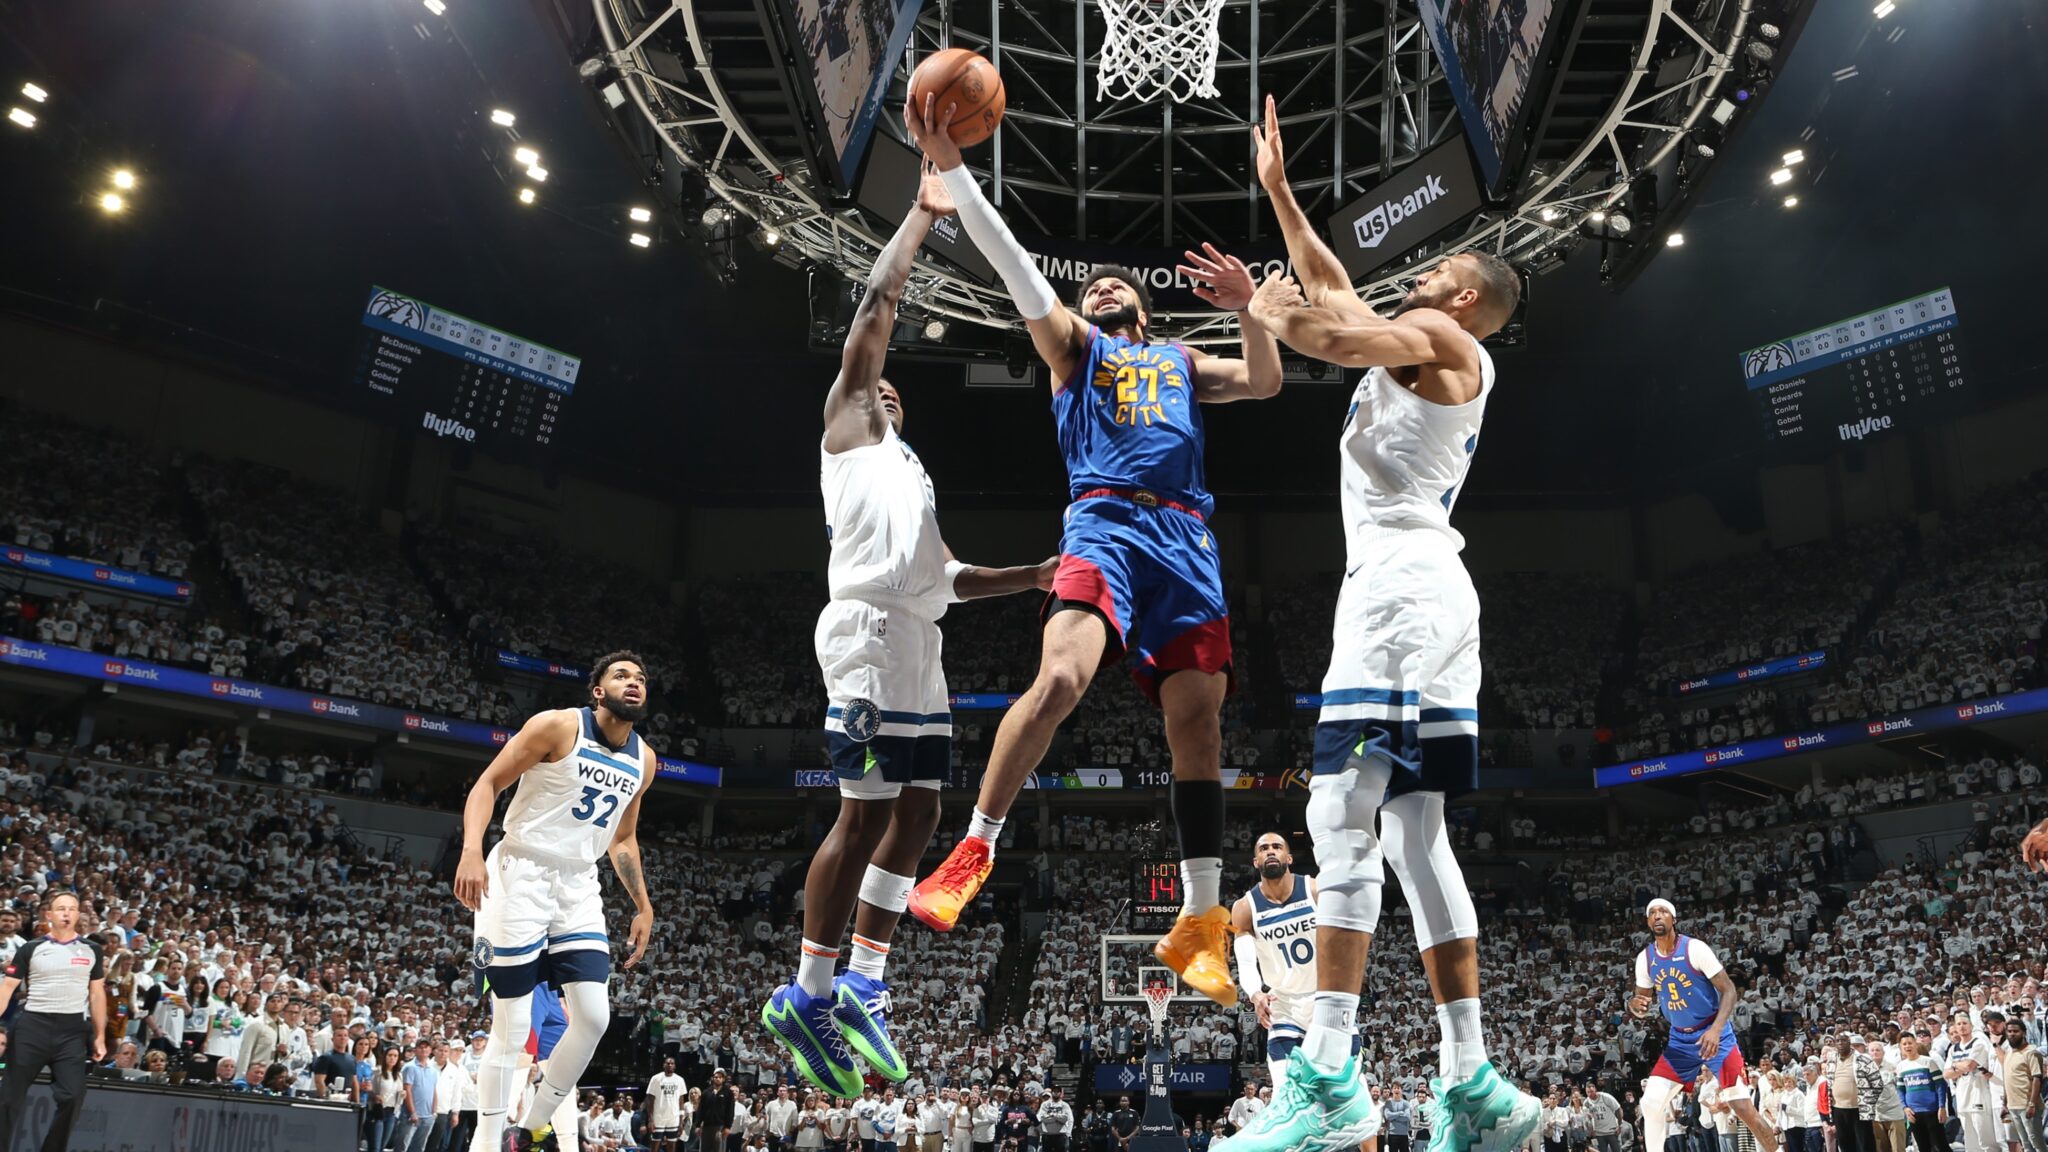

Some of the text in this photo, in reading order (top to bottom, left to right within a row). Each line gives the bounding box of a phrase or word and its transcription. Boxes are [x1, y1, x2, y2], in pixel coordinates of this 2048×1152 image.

[1358, 174, 1446, 242] us bank
[431, 323, 441, 332] 0.0
[450, 330, 460, 338] 0.0
[470, 336, 481, 346] 0.0
[381, 336, 421, 355] McDaniels
[1800, 348, 1810, 356] 0.0
[1818, 341, 1829, 350] 0.0
[1838, 336, 1849, 344] 0.0
[378, 347, 412, 364] Edwards
[464, 351, 476, 359] PTS
[1841, 351, 1852, 359] PTS
[374, 358, 402, 374] Conley
[1093, 348, 1182, 387] MILE HIGH
[372, 370, 398, 384] Gobert
[1116, 366, 1158, 403] 27
[368, 381, 393, 395] Towns
[1769, 378, 1805, 394] McDaniels
[1772, 391, 1802, 404] Edwards
[1116, 404, 1167, 426] CITY
[1774, 403, 1799, 415] Conley
[1777, 414, 1802, 425] Gobert
[1780, 425, 1803, 437] Towns
[24, 553, 51, 566] bank
[96, 570, 108, 578] us
[110, 570, 135, 584] bank
[560, 666, 579, 677] bank
[1681, 666, 1767, 690] us bank us bank
[11, 644, 505, 741] bank us bank us bank us bank us bank us
[1631, 701, 2005, 775] us bank us bank us bank us bank us bank
[664, 762, 687, 774] bank
[579, 762, 635, 796] WOLVES
[1099, 774, 1107, 787] 0
[1138, 772, 1172, 785] 11:0
[572, 786, 618, 828] 32
[1144, 864, 1176, 876] 11:07
[1152, 878, 1174, 901] 14
[1260, 918, 1316, 941] WOLVES
[1277, 938, 1314, 968] 10
[1670, 967, 1692, 988] HIGH
[1668, 982, 1678, 1000] 5
[1668, 998, 1688, 1011] CITY
[1152, 1064, 1164, 1074] GET
[1139, 1072, 1206, 1083] PTAIR
[1152, 1075, 1164, 1084] THE
[1156, 1086, 1166, 1097] App
